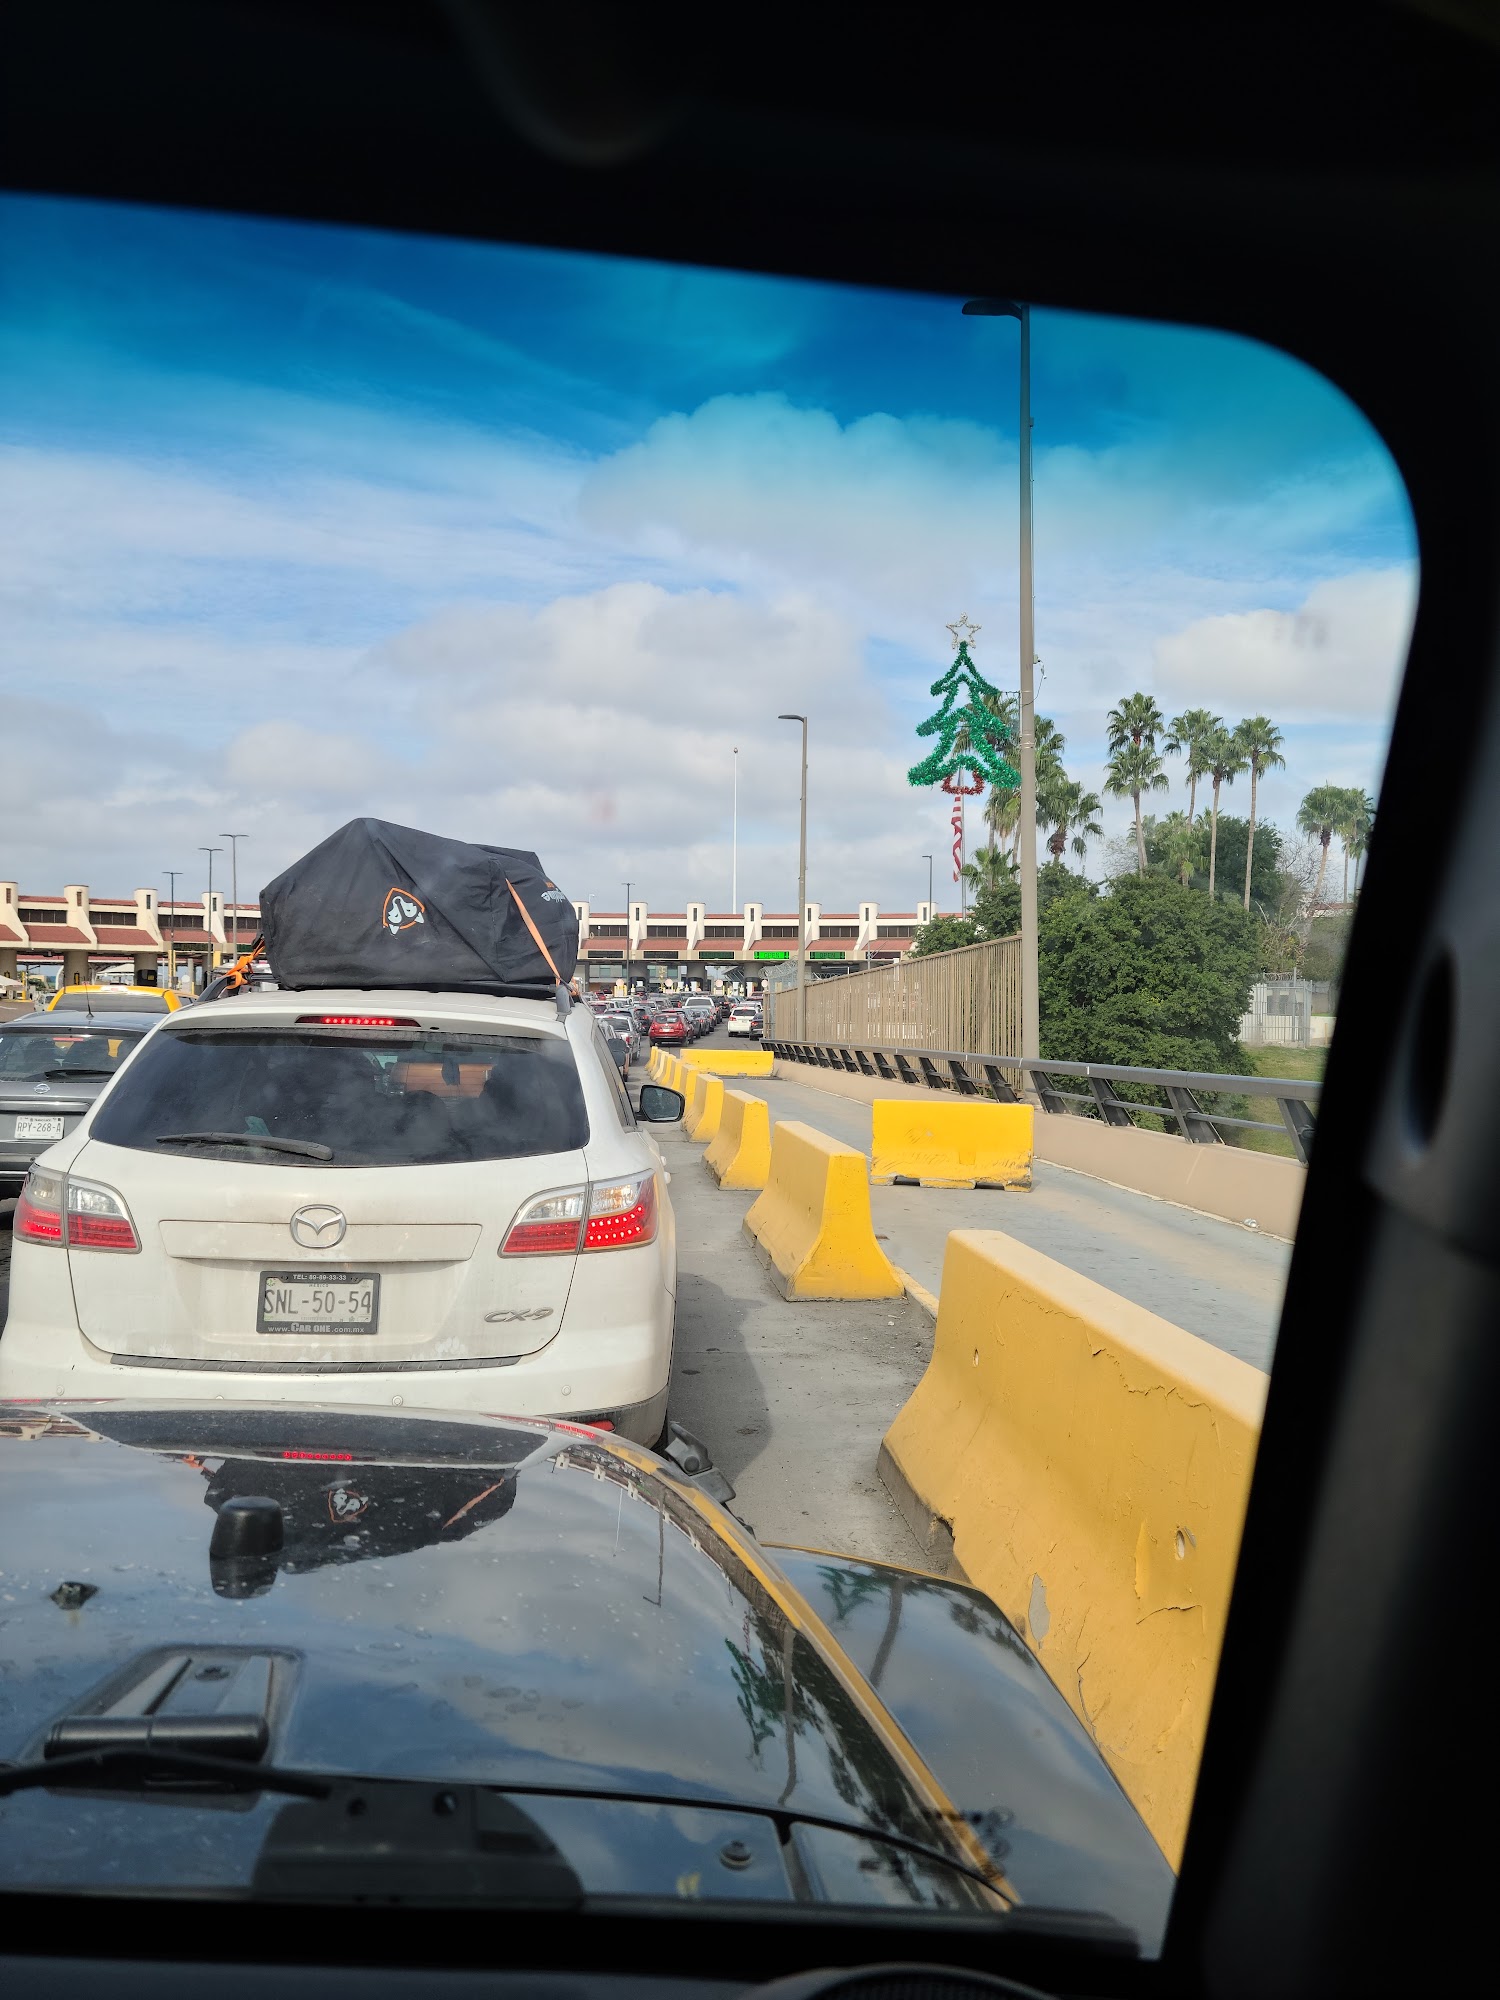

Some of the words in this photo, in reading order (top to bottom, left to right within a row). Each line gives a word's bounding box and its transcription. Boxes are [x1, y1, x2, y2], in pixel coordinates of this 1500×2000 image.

[17, 1121, 61, 1133] RPY-268-A
[265, 1289, 372, 1315] SNL-50-54
[484, 1306, 554, 1323] CX-9
